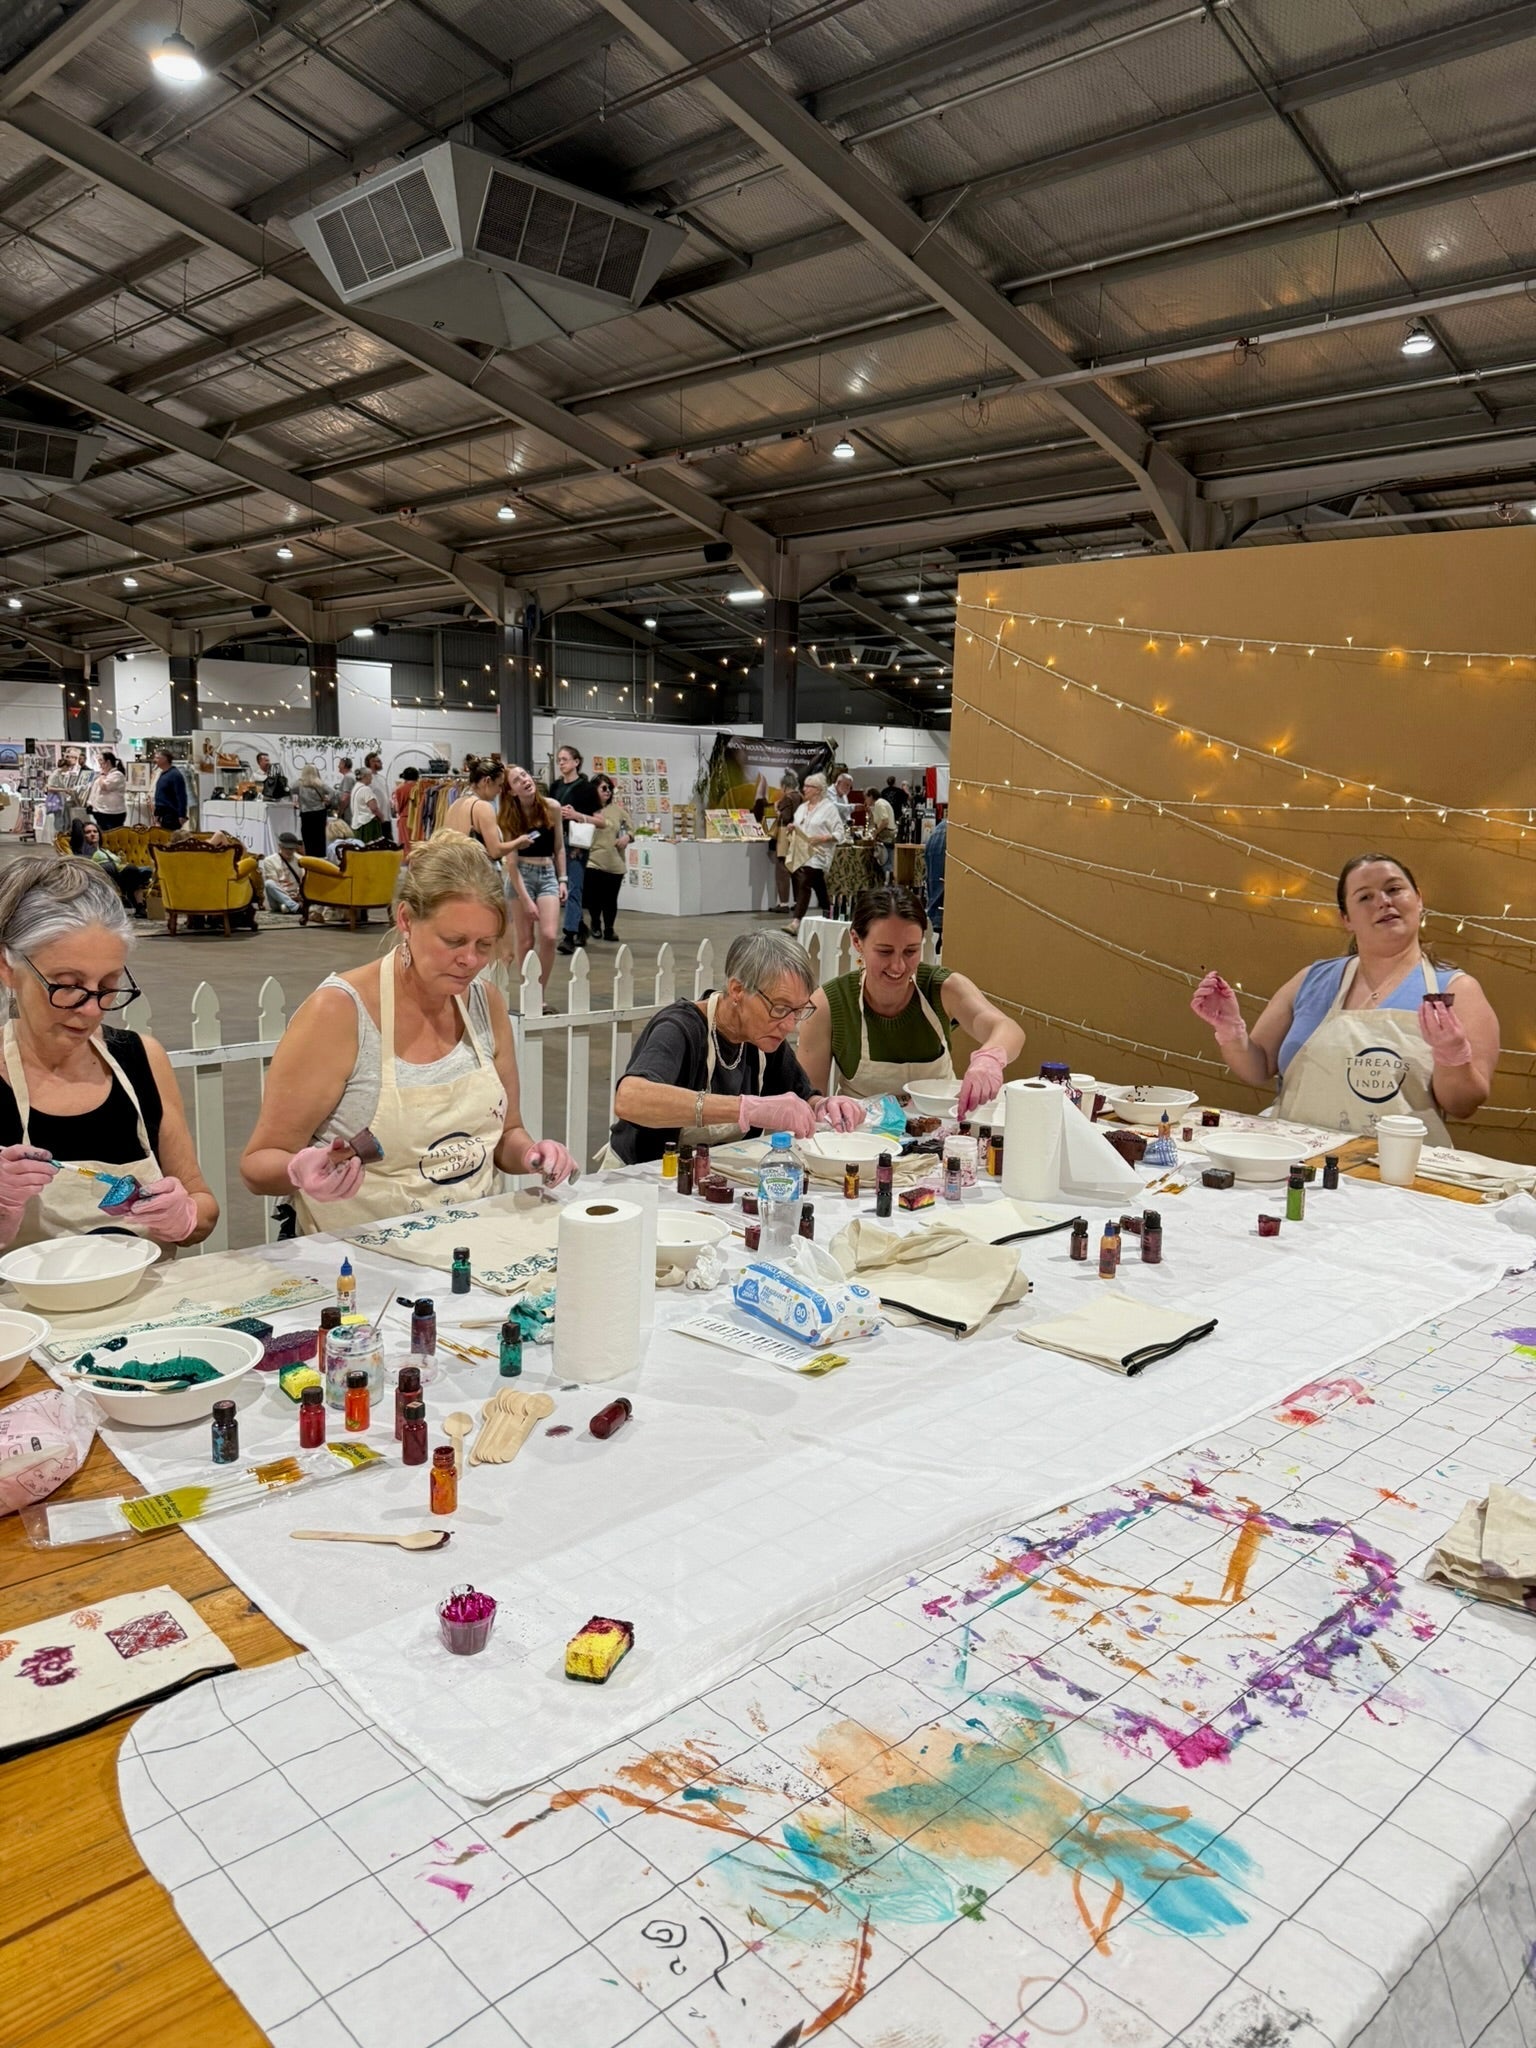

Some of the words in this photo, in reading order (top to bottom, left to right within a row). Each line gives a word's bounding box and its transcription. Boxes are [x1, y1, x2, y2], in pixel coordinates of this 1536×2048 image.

[1345, 1057, 1410, 1071] THREADS
[1356, 1080, 1395, 1089] INDIA
[796, 1306, 806, 1317] 80
